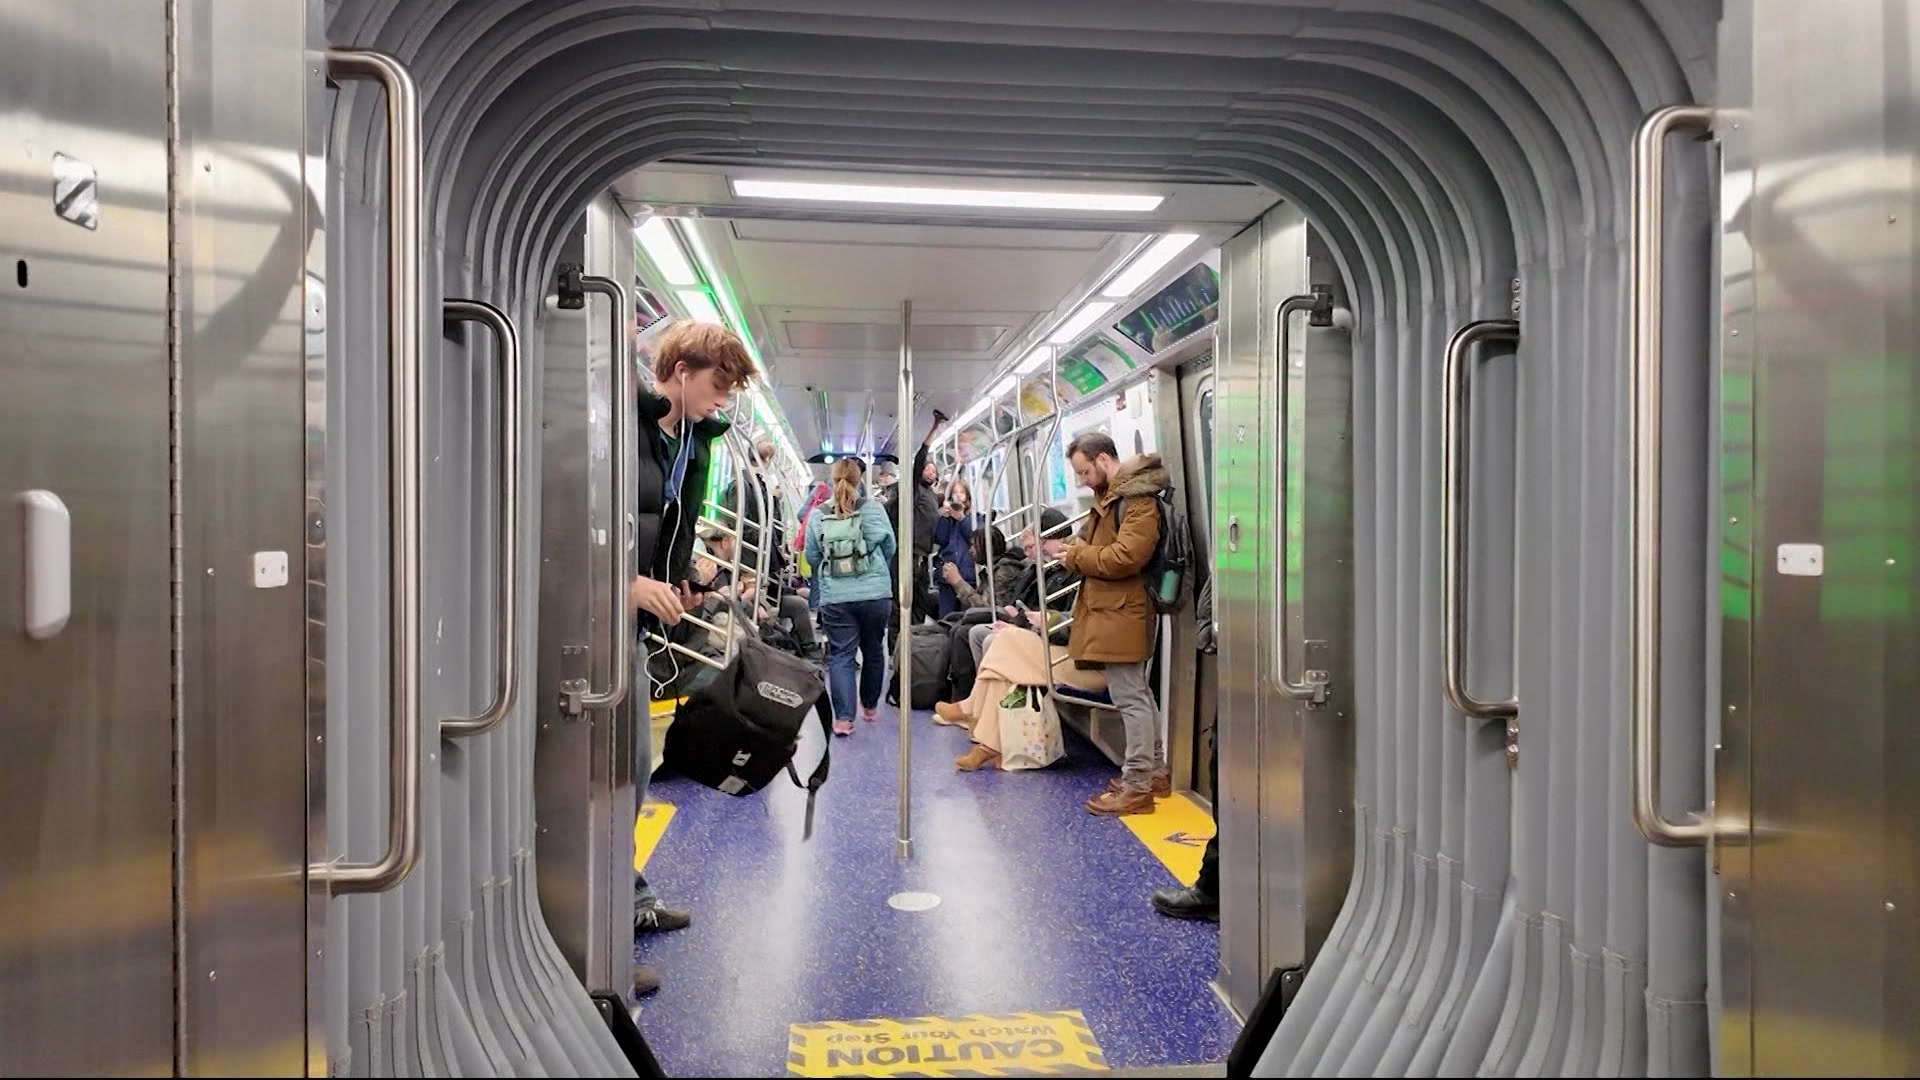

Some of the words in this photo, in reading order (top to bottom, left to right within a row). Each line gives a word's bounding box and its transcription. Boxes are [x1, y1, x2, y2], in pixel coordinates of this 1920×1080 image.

[901, 1029, 960, 1040] Your
[967, 1024, 1056, 1038] Watch
[827, 1039, 1065, 1067] CAUTION
